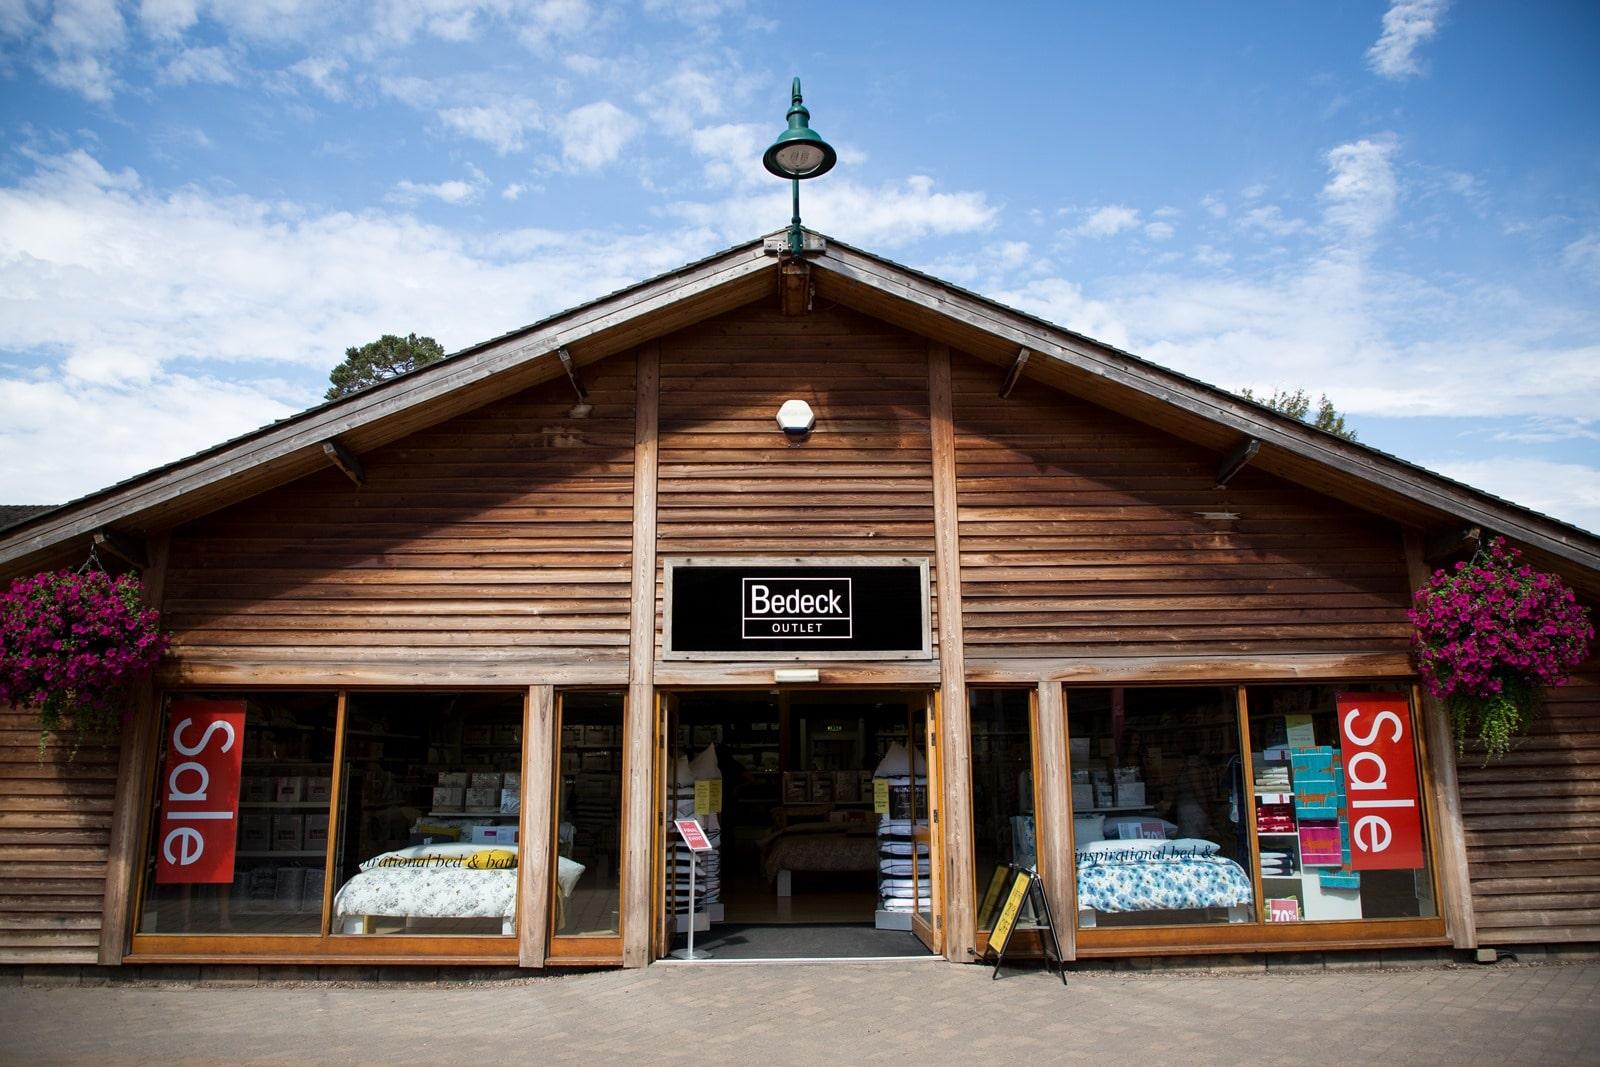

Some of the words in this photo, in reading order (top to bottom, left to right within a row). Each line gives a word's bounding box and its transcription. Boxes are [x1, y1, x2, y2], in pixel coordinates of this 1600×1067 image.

[751, 584, 843, 614] Bedeck
[771, 623, 823, 633] OUTLET
[1343, 708, 1415, 853] Sale
[163, 717, 235, 866] Sale
[435, 853, 464, 868] bed
[467, 854, 479, 868] &
[1074, 846, 1167, 864] inspirational
[1171, 845, 1197, 860] bed
[1200, 845, 1214, 859] &
[1272, 909, 1297, 922] 70%
